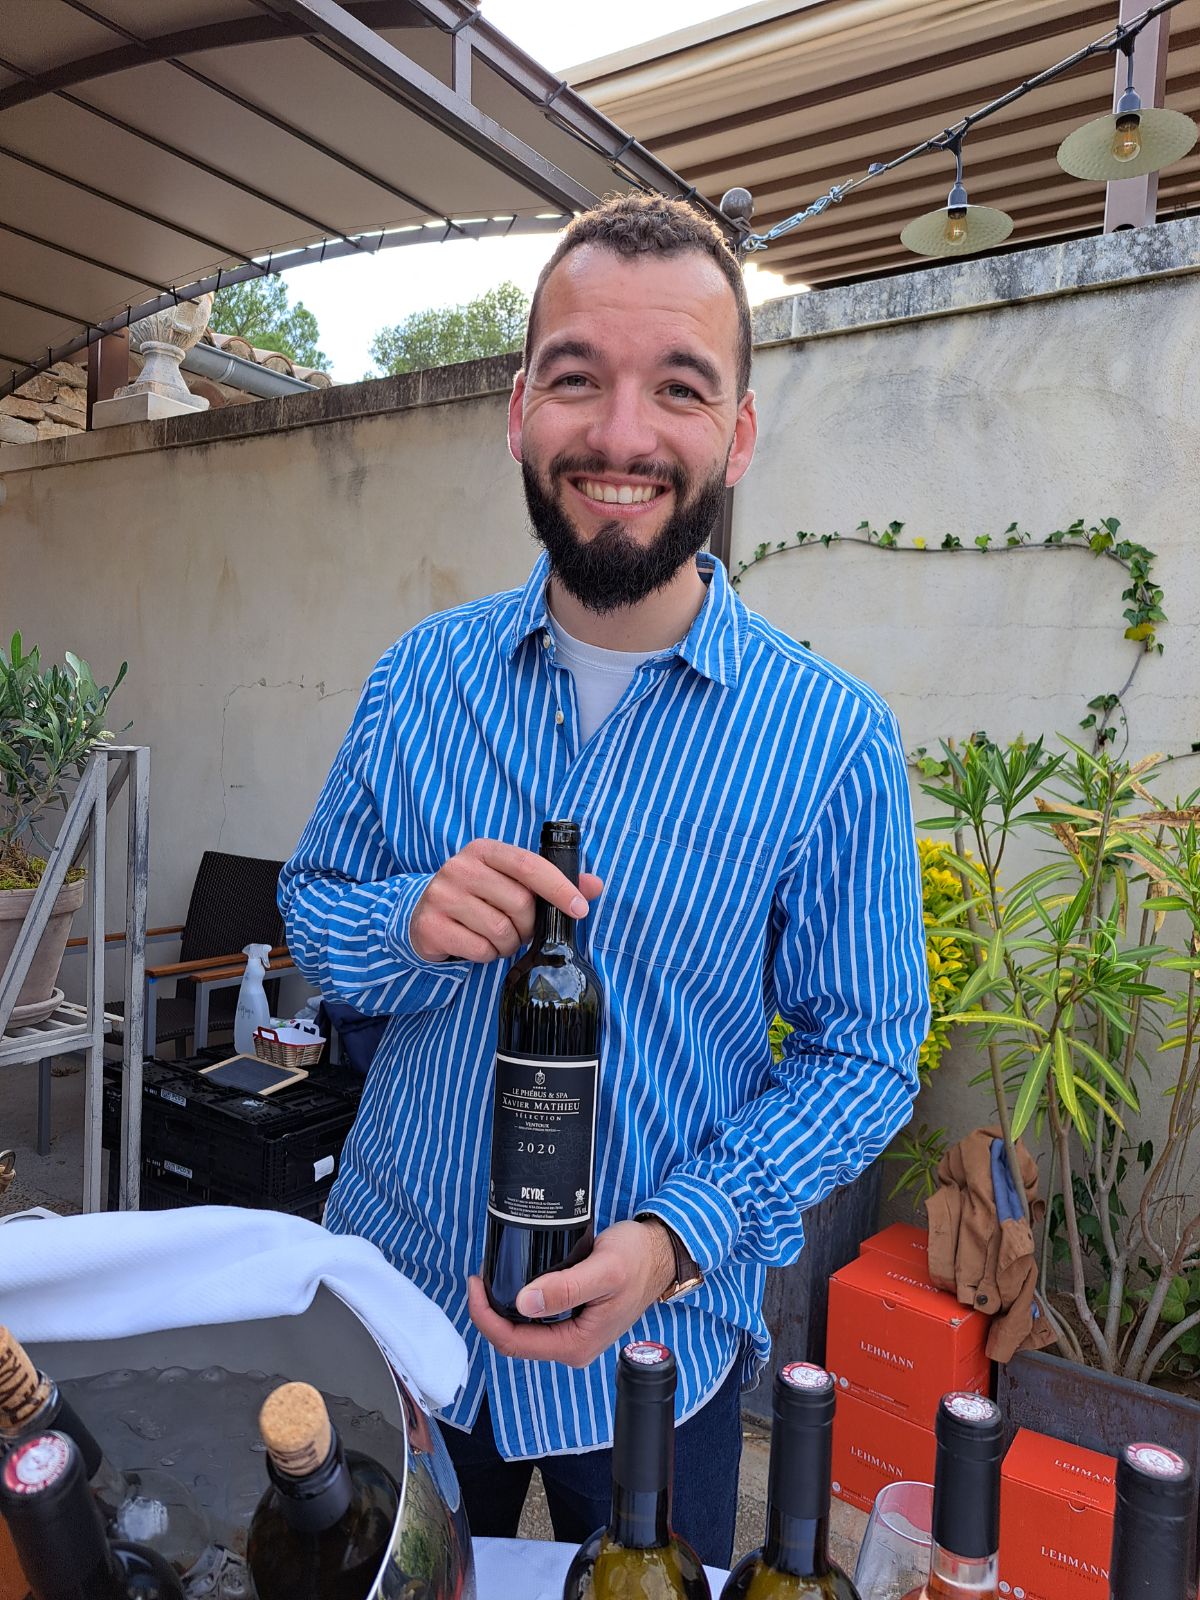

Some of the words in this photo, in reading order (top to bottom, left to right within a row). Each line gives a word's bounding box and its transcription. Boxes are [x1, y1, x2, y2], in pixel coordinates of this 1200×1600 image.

[520, 1089, 547, 1098] PHÉBUS
[502, 1096, 530, 1109] XAVIER
[534, 1102, 580, 1111] MATHIEU
[517, 1141, 556, 1155] 2020
[521, 1186, 545, 1201] PEYRE
[886, 1271, 939, 1293] LEHMANN
[860, 1340, 914, 1369] LEHMANN
[850, 1446, 903, 1477] LEHMANN
[1041, 1545, 1109, 1580] LEHMANN
